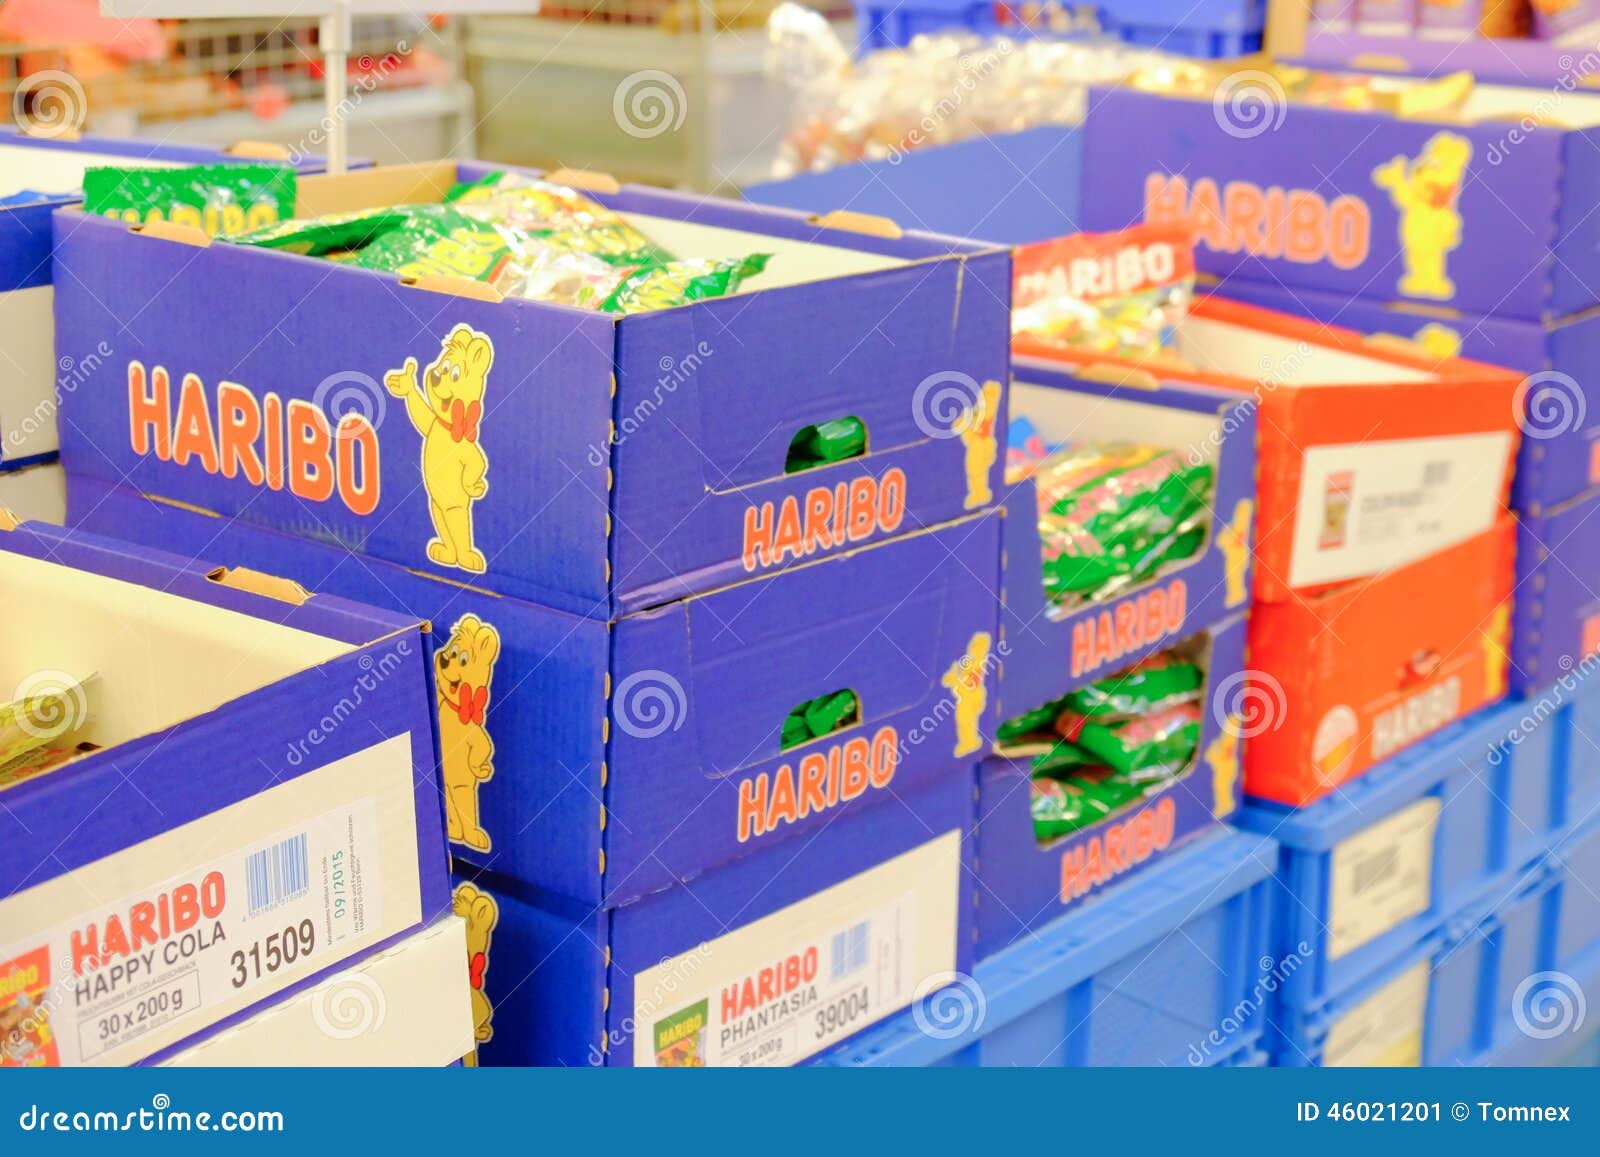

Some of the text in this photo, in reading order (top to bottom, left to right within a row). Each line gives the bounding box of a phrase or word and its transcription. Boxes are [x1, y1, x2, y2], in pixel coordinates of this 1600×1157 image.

[1144, 171, 1371, 270] HARIBO
[128, 360, 380, 516] HARIBO
[743, 467, 906, 571] HARIBO
[1071, 579, 1187, 678] HARIBO
[737, 726, 899, 842] HARIBO
[1061, 797, 1175, 903] HARIBO
[70, 871, 226, 977] HARIBO
[75, 948, 156, 1006] HAPPY
[163, 920, 226, 965] COLA
[230, 918, 315, 989] 31509
[98, 1014, 120, 1039] 30
[123, 1011, 134, 1029] x
[137, 991, 168, 1022] 200
[171, 988, 183, 1010] g
[720, 946, 818, 1024] HARIBO
[720, 985, 818, 1048] PHANTASIA
[815, 986, 869, 1039] 39004
